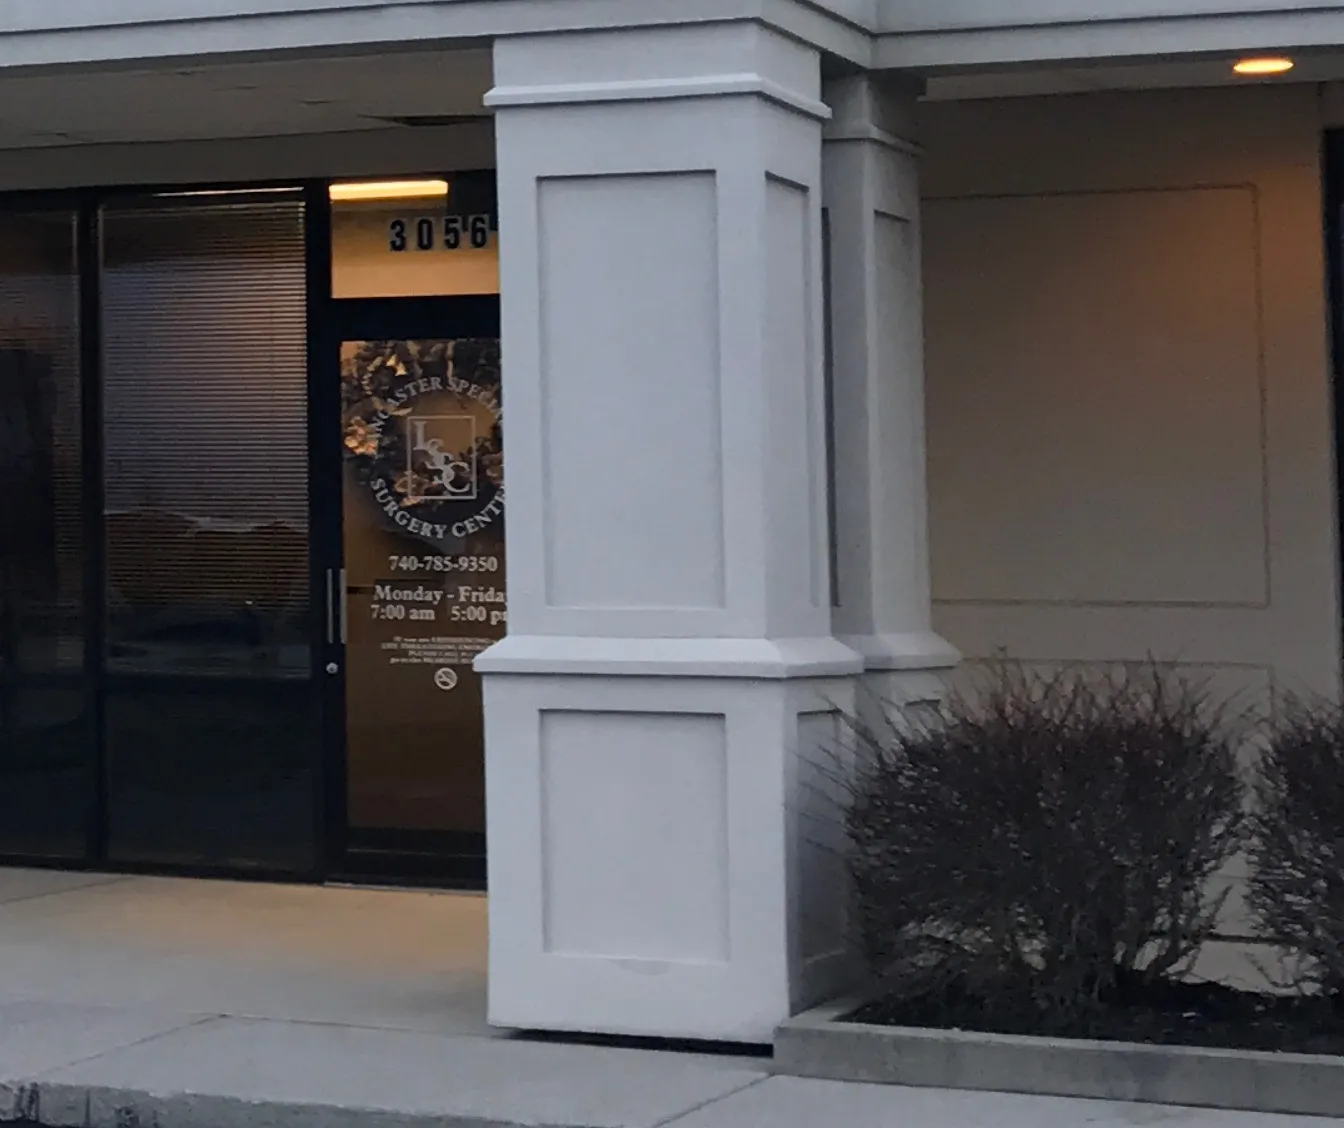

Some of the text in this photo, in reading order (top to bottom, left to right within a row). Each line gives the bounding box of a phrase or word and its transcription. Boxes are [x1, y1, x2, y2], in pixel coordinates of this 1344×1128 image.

[389, 216, 488, 251] 3056
[370, 477, 507, 540] SURGERY CENTE
[388, 555, 499, 572] 740-785-9350
[373, 585, 444, 605] Monday
[458, 586, 506, 605] Frida
[370, 604, 406, 621] 7:00
[408, 607, 436, 621] am
[450, 605, 487, 622] 5:00
